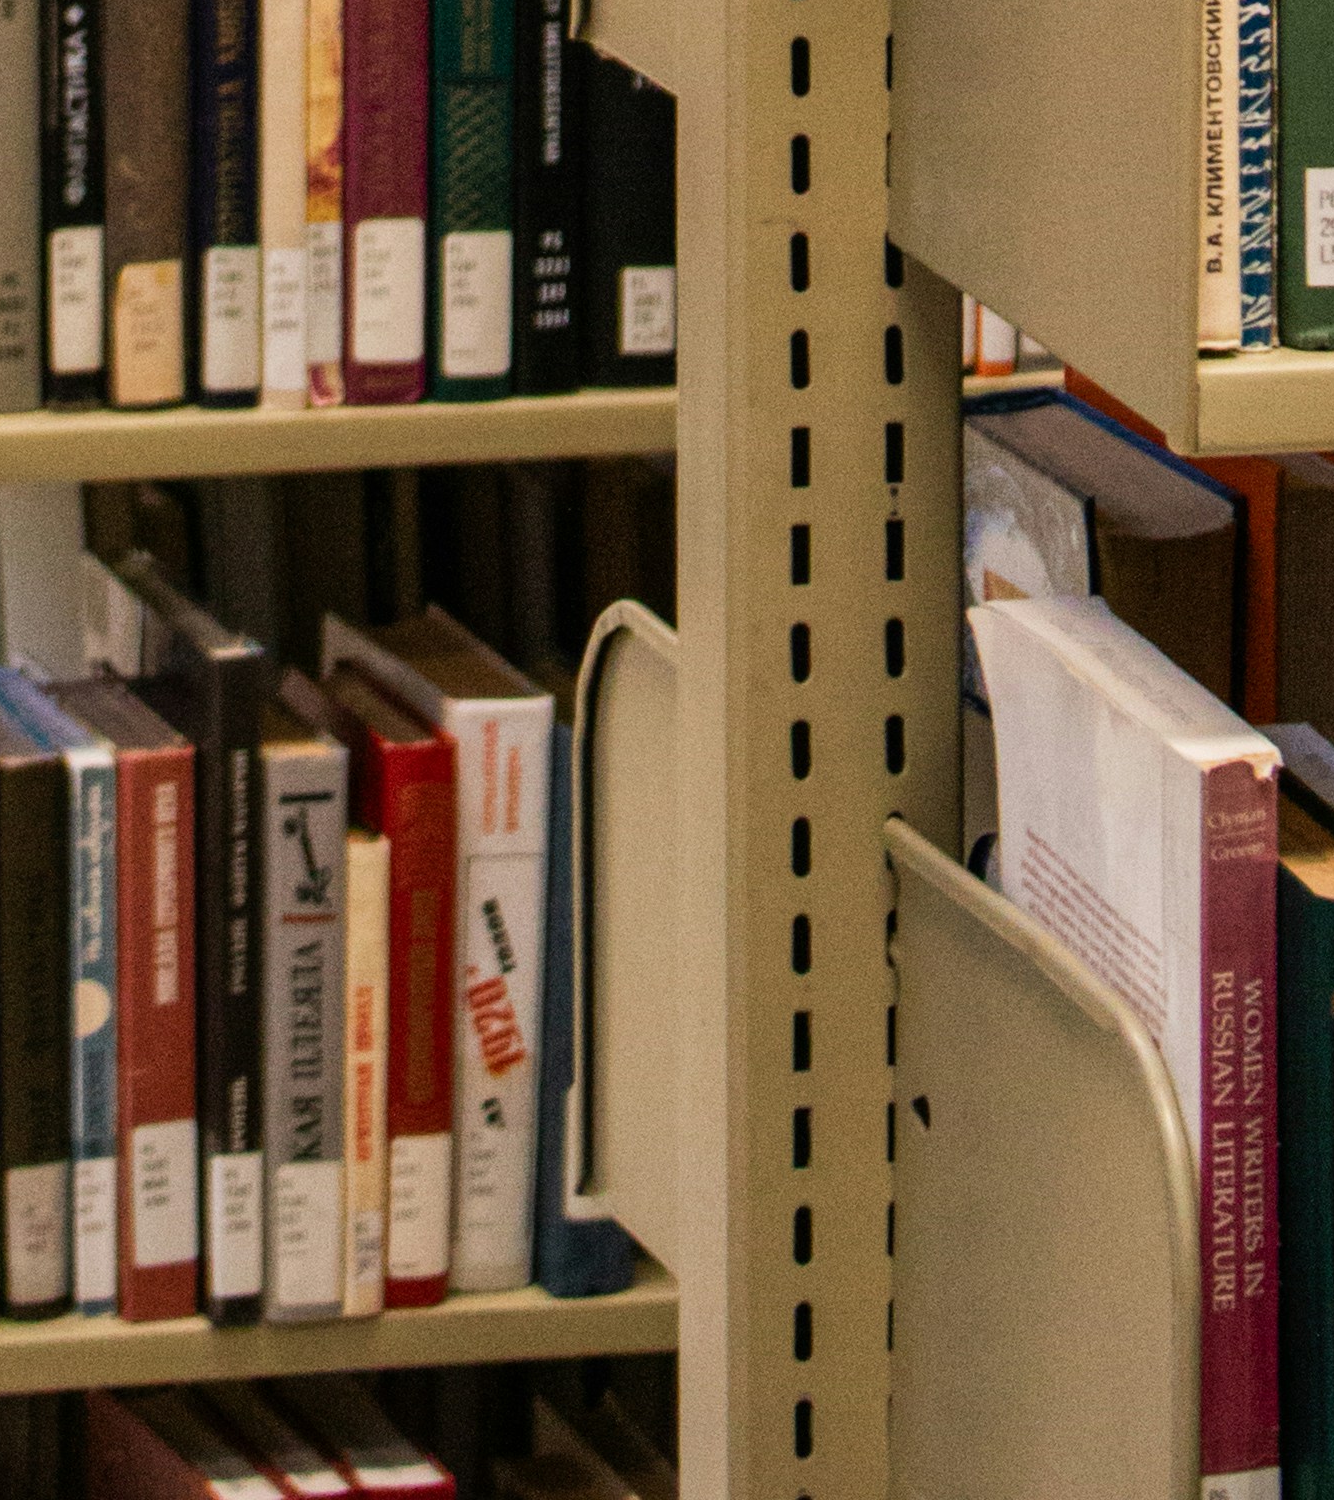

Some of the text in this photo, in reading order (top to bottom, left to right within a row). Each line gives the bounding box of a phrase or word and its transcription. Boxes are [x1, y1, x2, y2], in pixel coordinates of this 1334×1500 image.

[1209, 971, 1236, 1312] RUSSIAN LITERATURE
[1244, 977, 1267, 1242] WOMEN WRITERS
